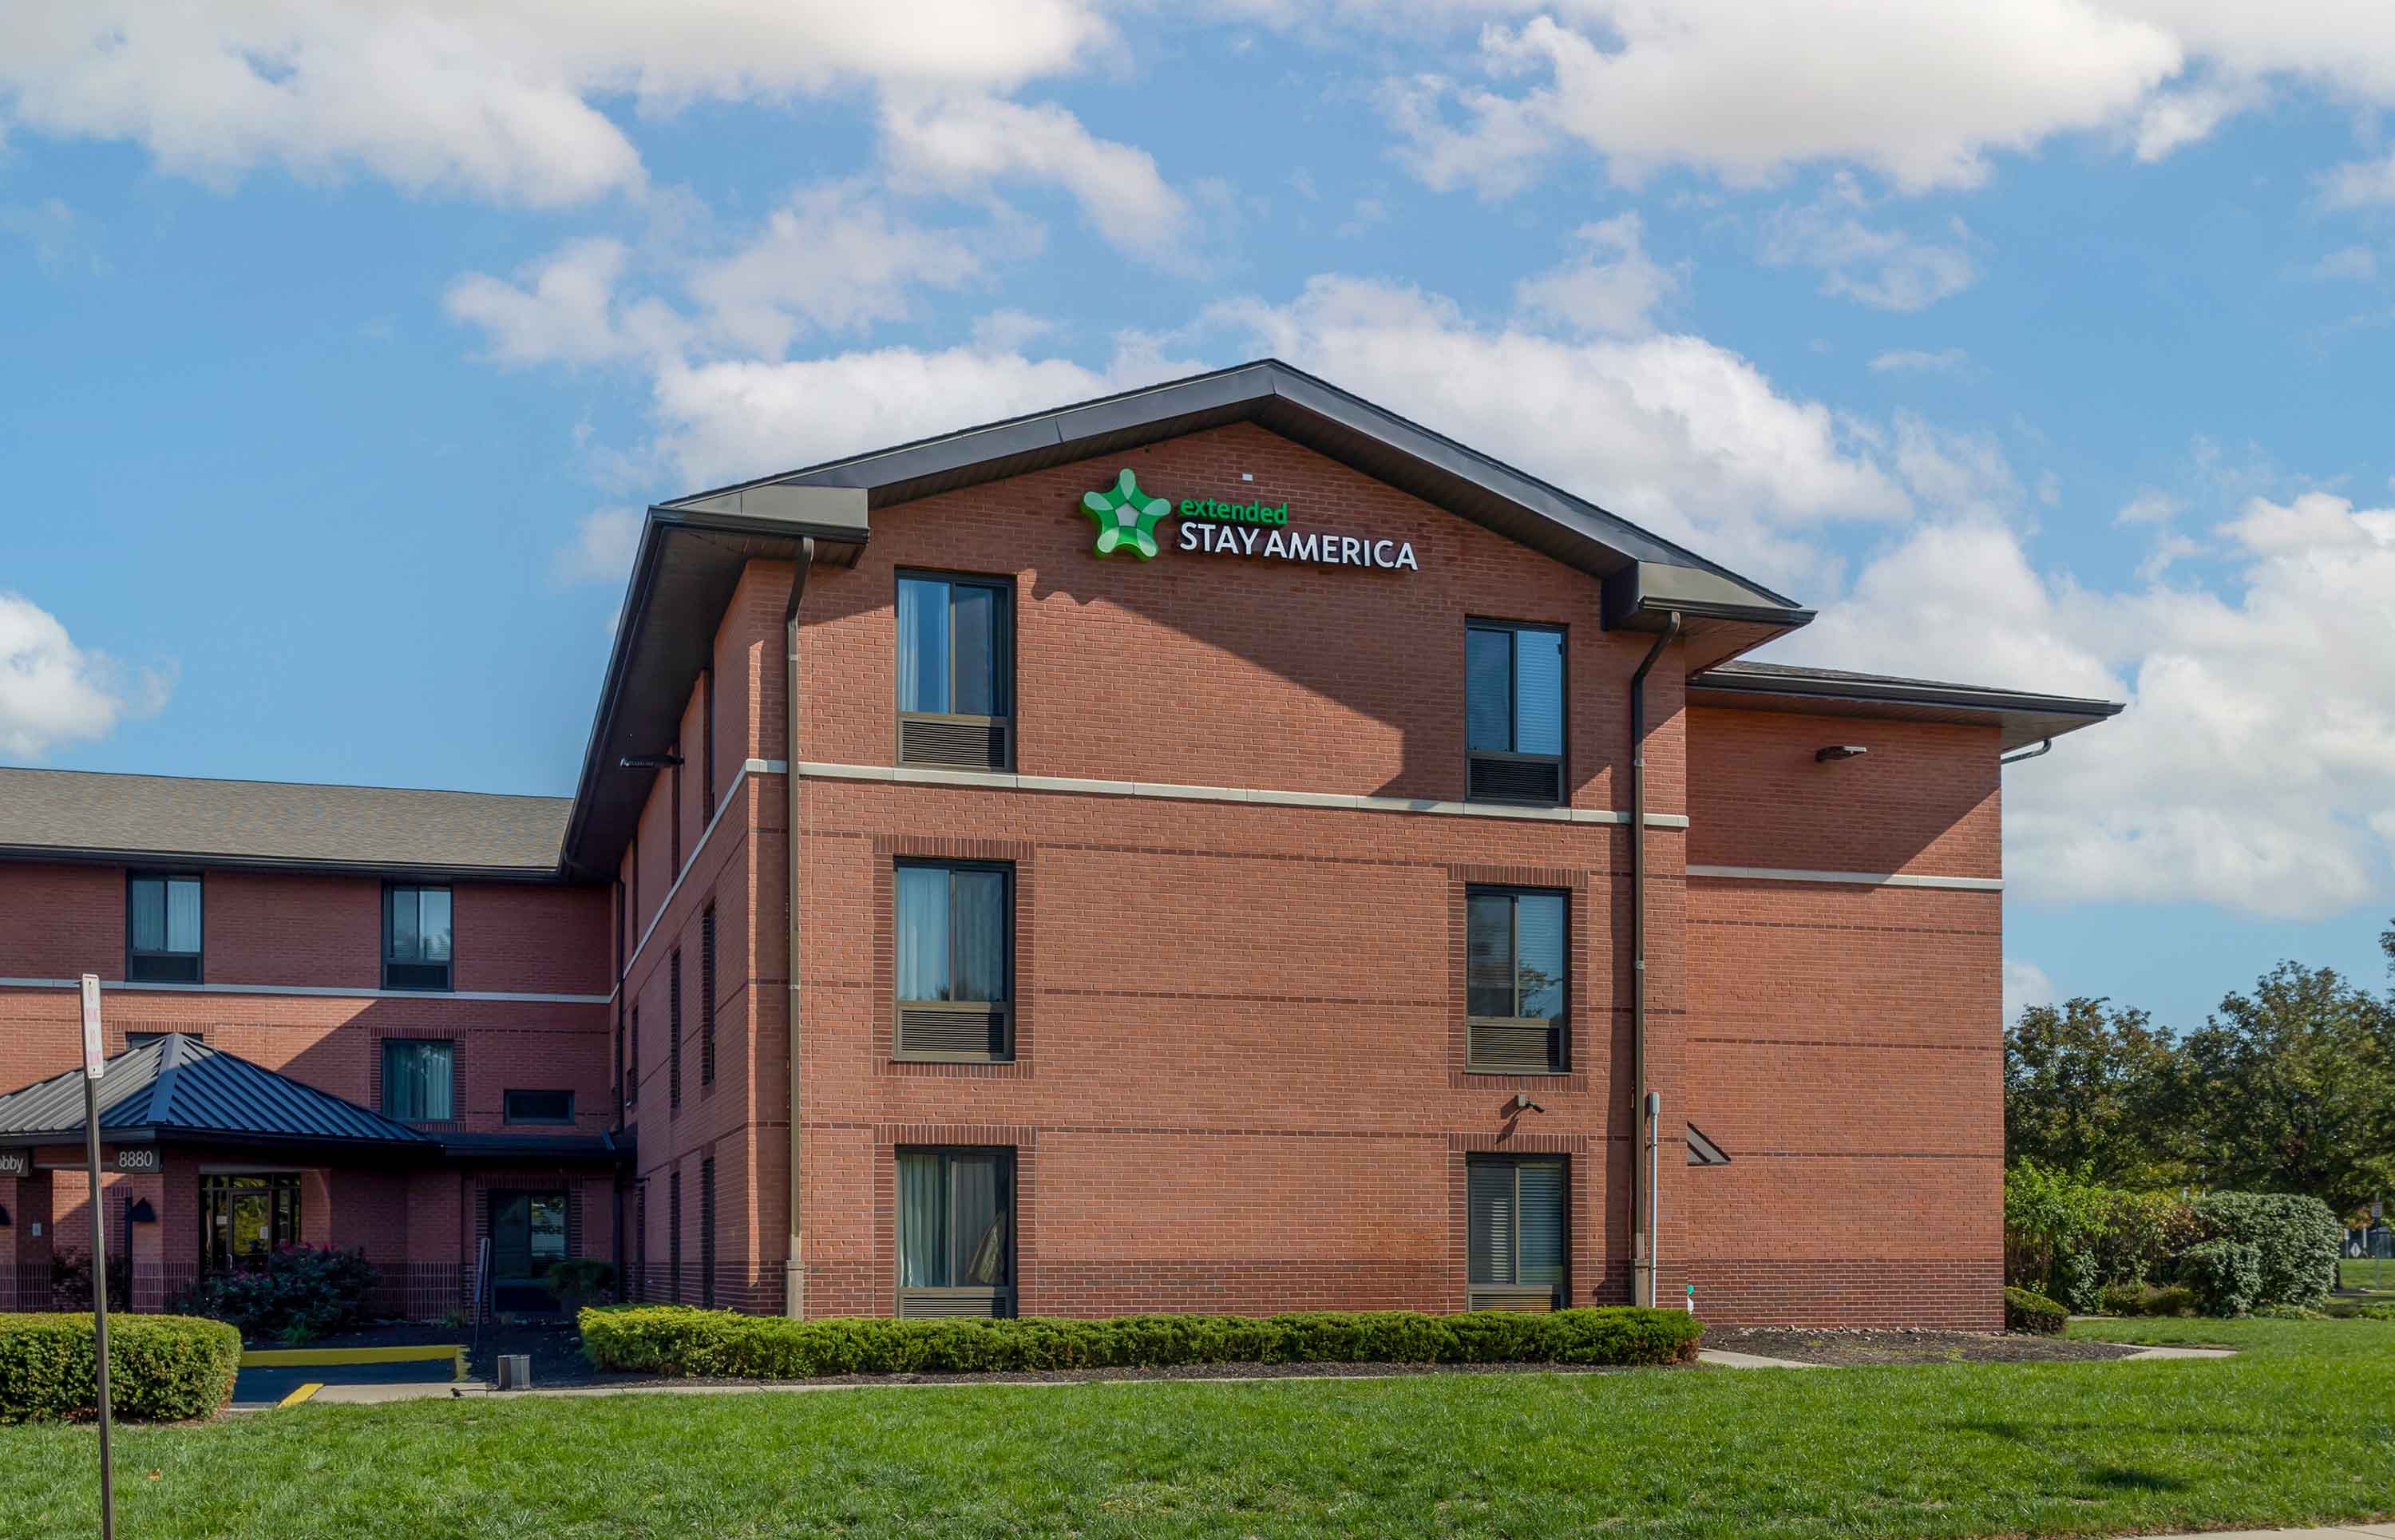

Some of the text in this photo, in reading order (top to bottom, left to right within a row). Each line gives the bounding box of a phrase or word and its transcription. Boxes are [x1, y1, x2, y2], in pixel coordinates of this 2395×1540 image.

[1180, 497, 1289, 525] extended
[1180, 521, 1419, 571] STAY AMERICA
[119, 1150, 153, 1167] 8880
